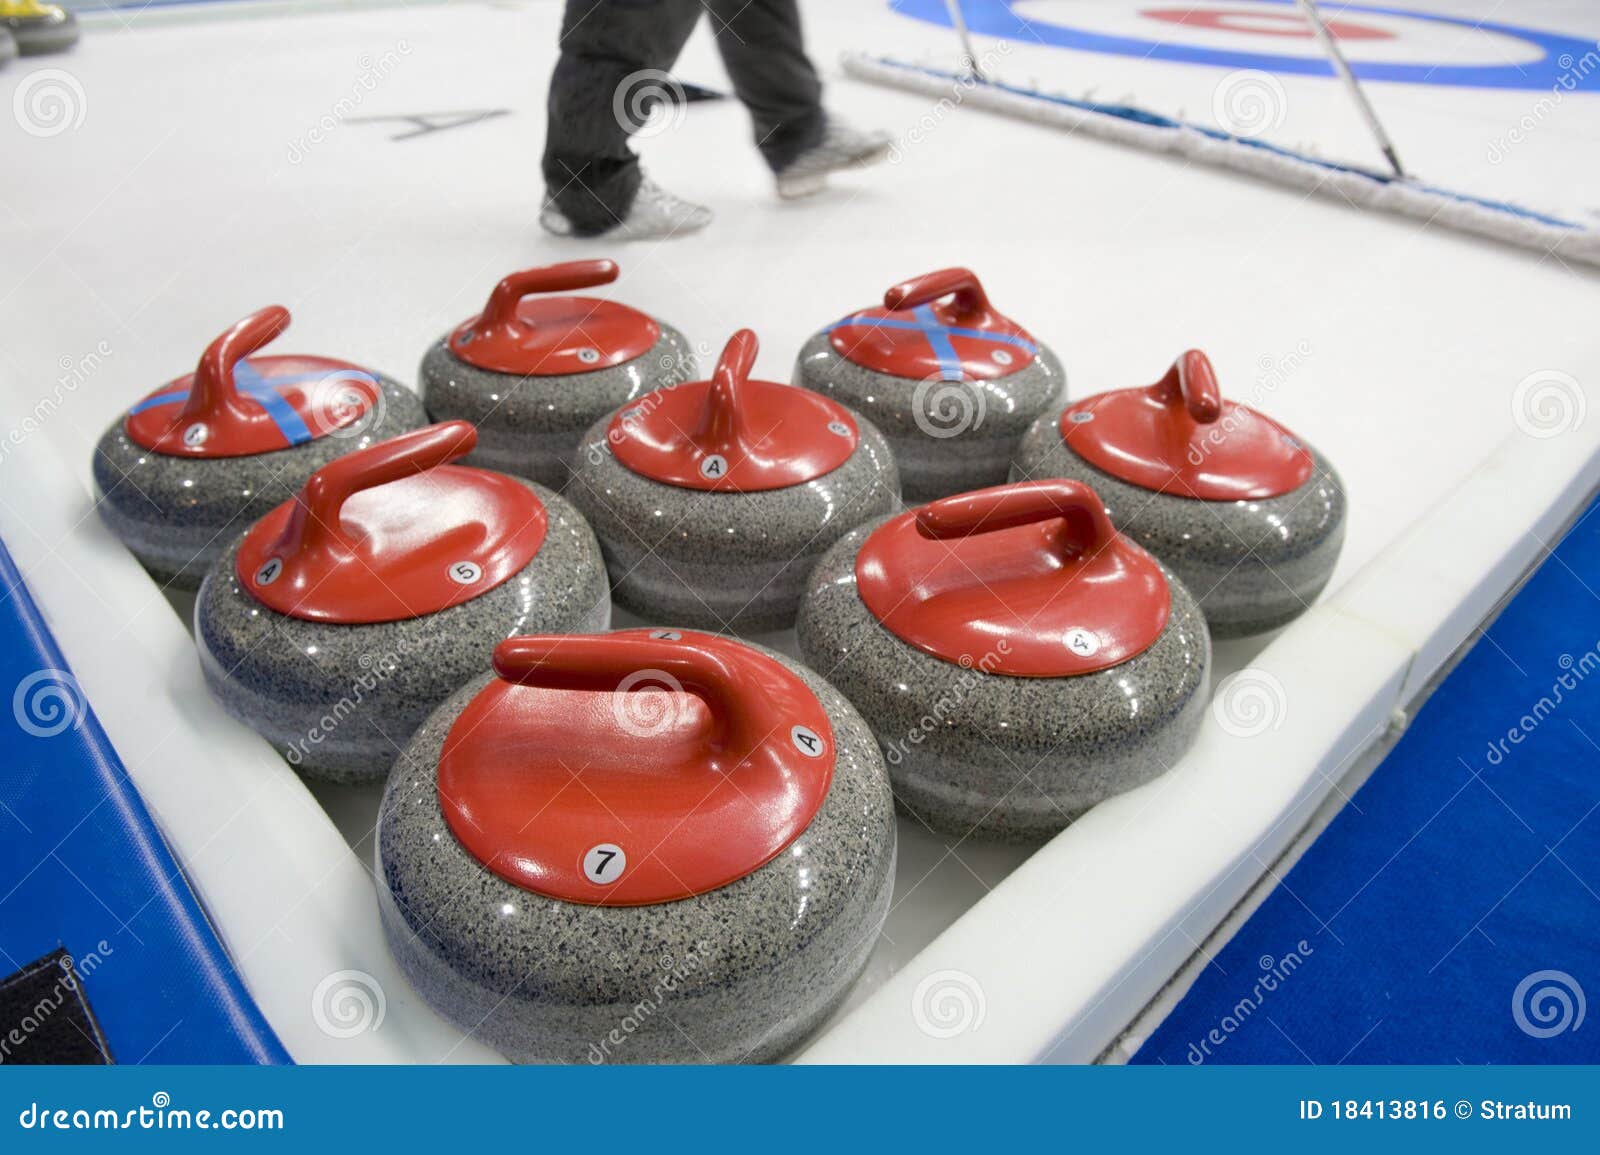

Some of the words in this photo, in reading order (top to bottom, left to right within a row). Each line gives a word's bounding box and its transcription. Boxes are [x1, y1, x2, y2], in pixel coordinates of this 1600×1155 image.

[706, 460, 720, 475] A
[260, 563, 277, 582] A
[456, 564, 475, 580] 5
[796, 732, 817, 753] A
[595, 849, 617, 875] 7
